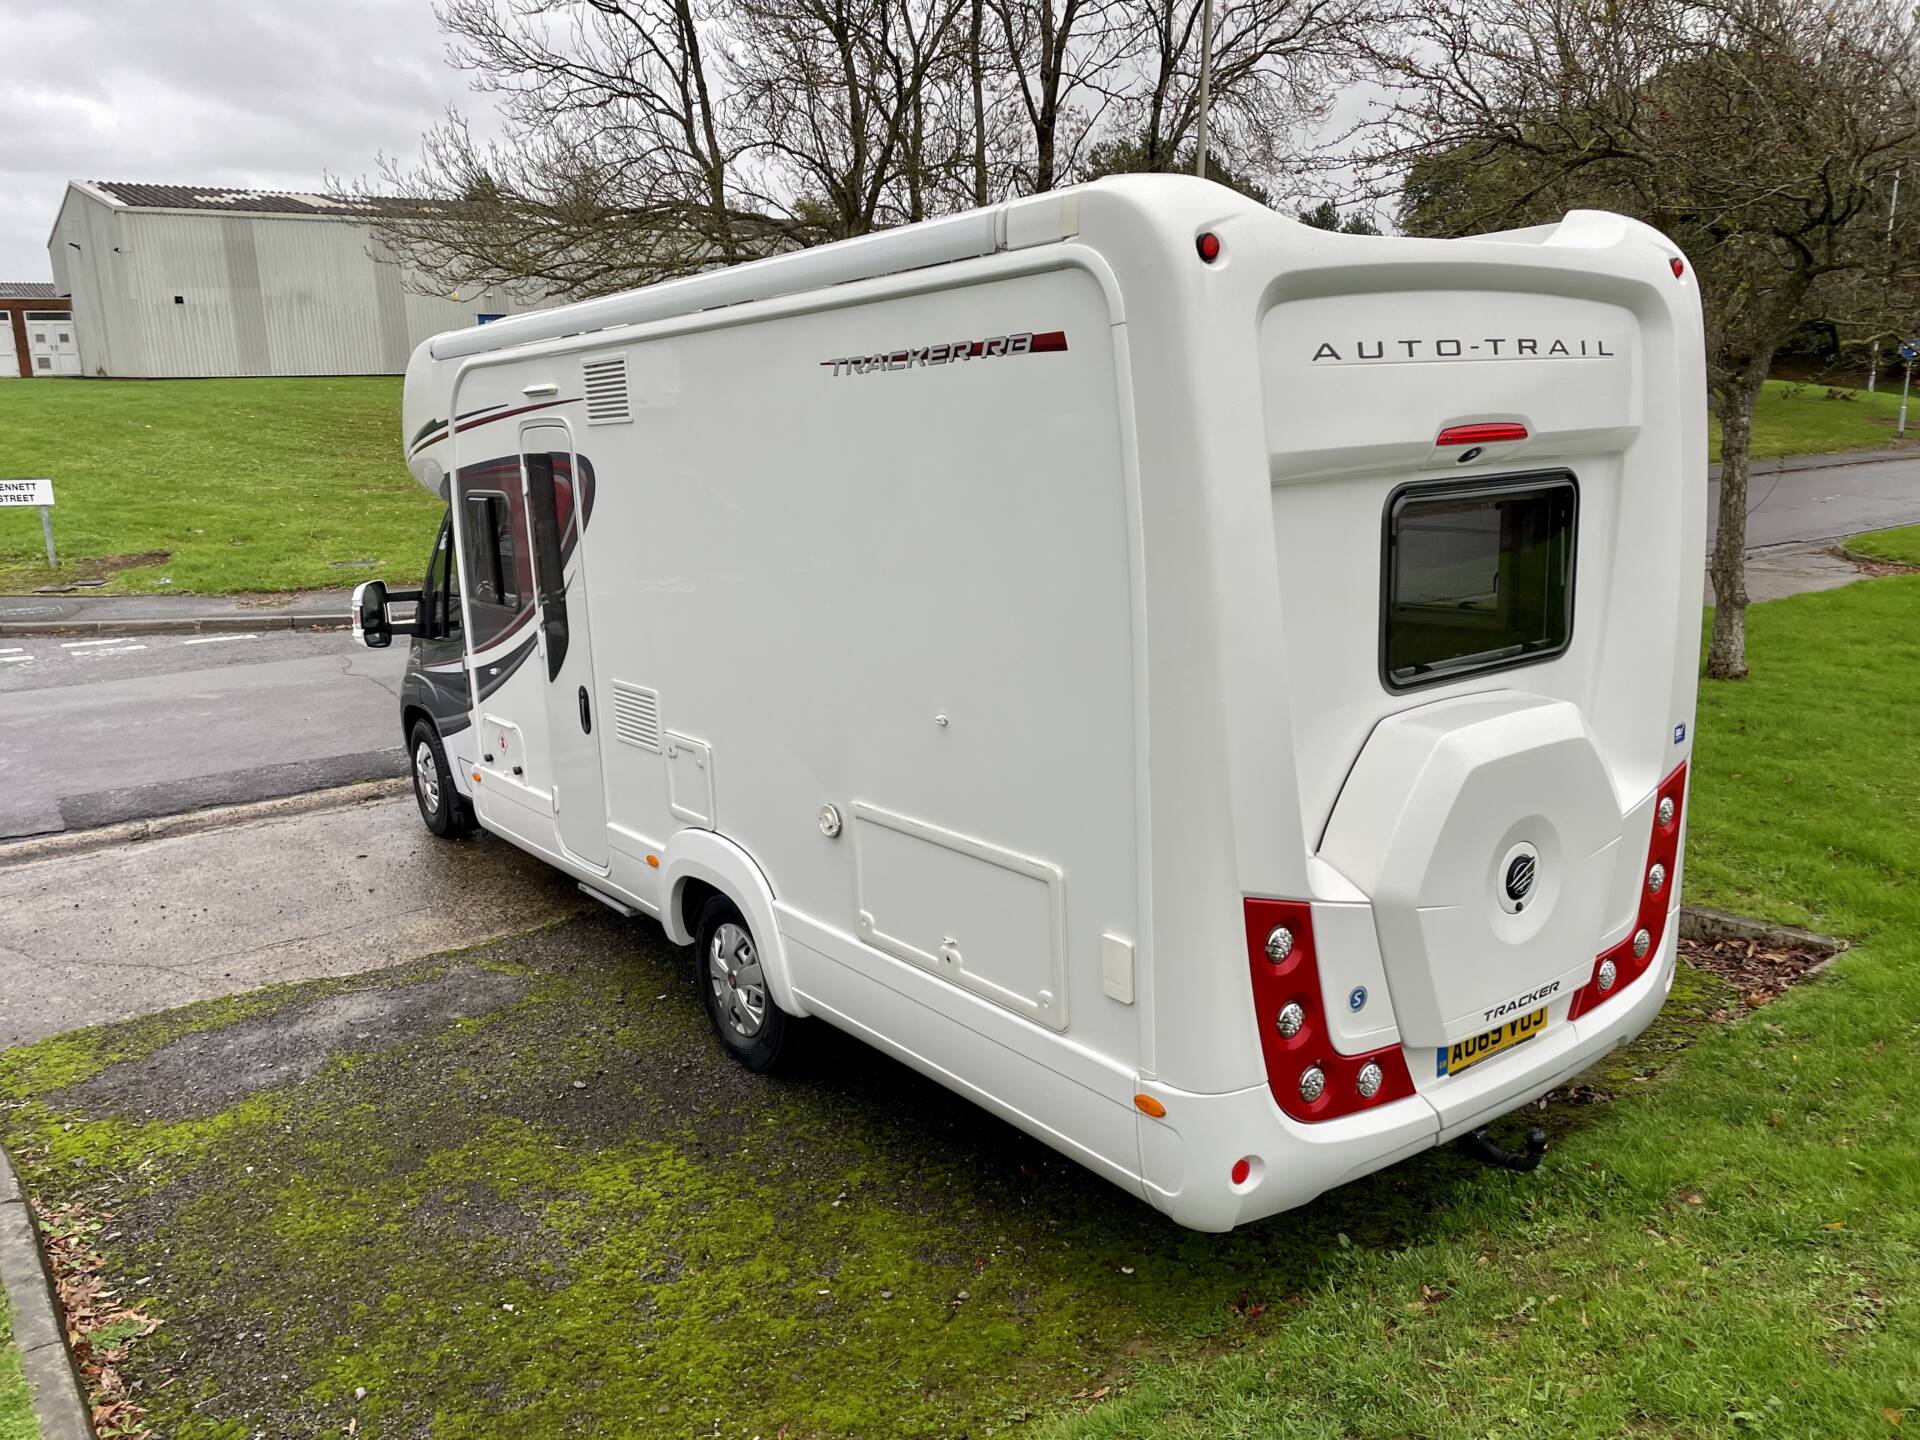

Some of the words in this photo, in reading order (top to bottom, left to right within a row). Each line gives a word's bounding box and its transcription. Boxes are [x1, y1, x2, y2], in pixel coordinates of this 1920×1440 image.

[830, 340, 973, 377] TRACKER
[981, 332, 1033, 359] RB
[1311, 338, 1615, 362] AUTO-TRAIL
[0, 494, 35, 503] STREET
[1483, 980, 1561, 1022] TRACKER
